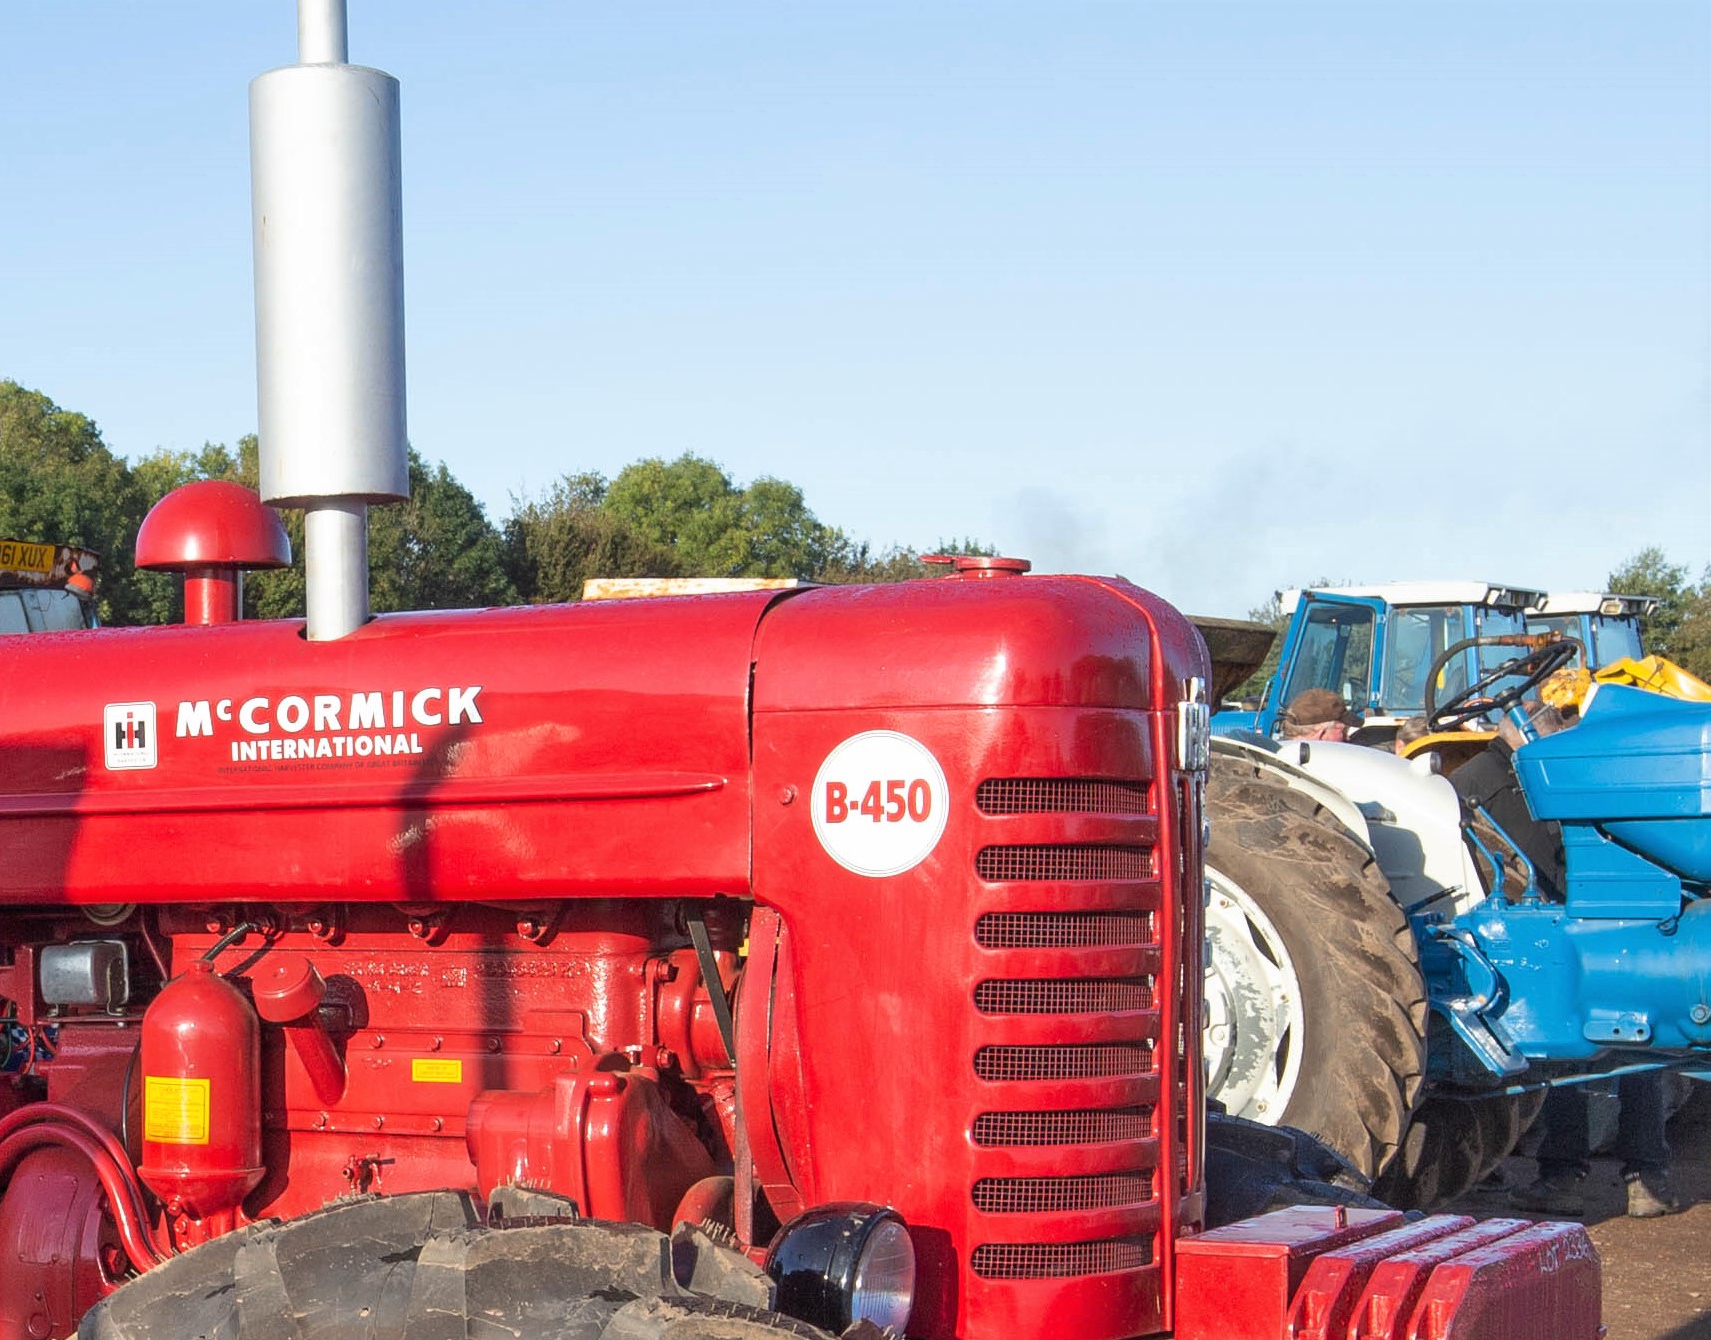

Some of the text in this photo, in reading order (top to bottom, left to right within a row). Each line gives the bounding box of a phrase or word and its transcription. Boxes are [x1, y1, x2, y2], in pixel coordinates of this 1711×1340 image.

[18, 546, 47, 568] XUX
[231, 733, 423, 761] INTERNATIONAL
[825, 778, 932, 824] B-450
